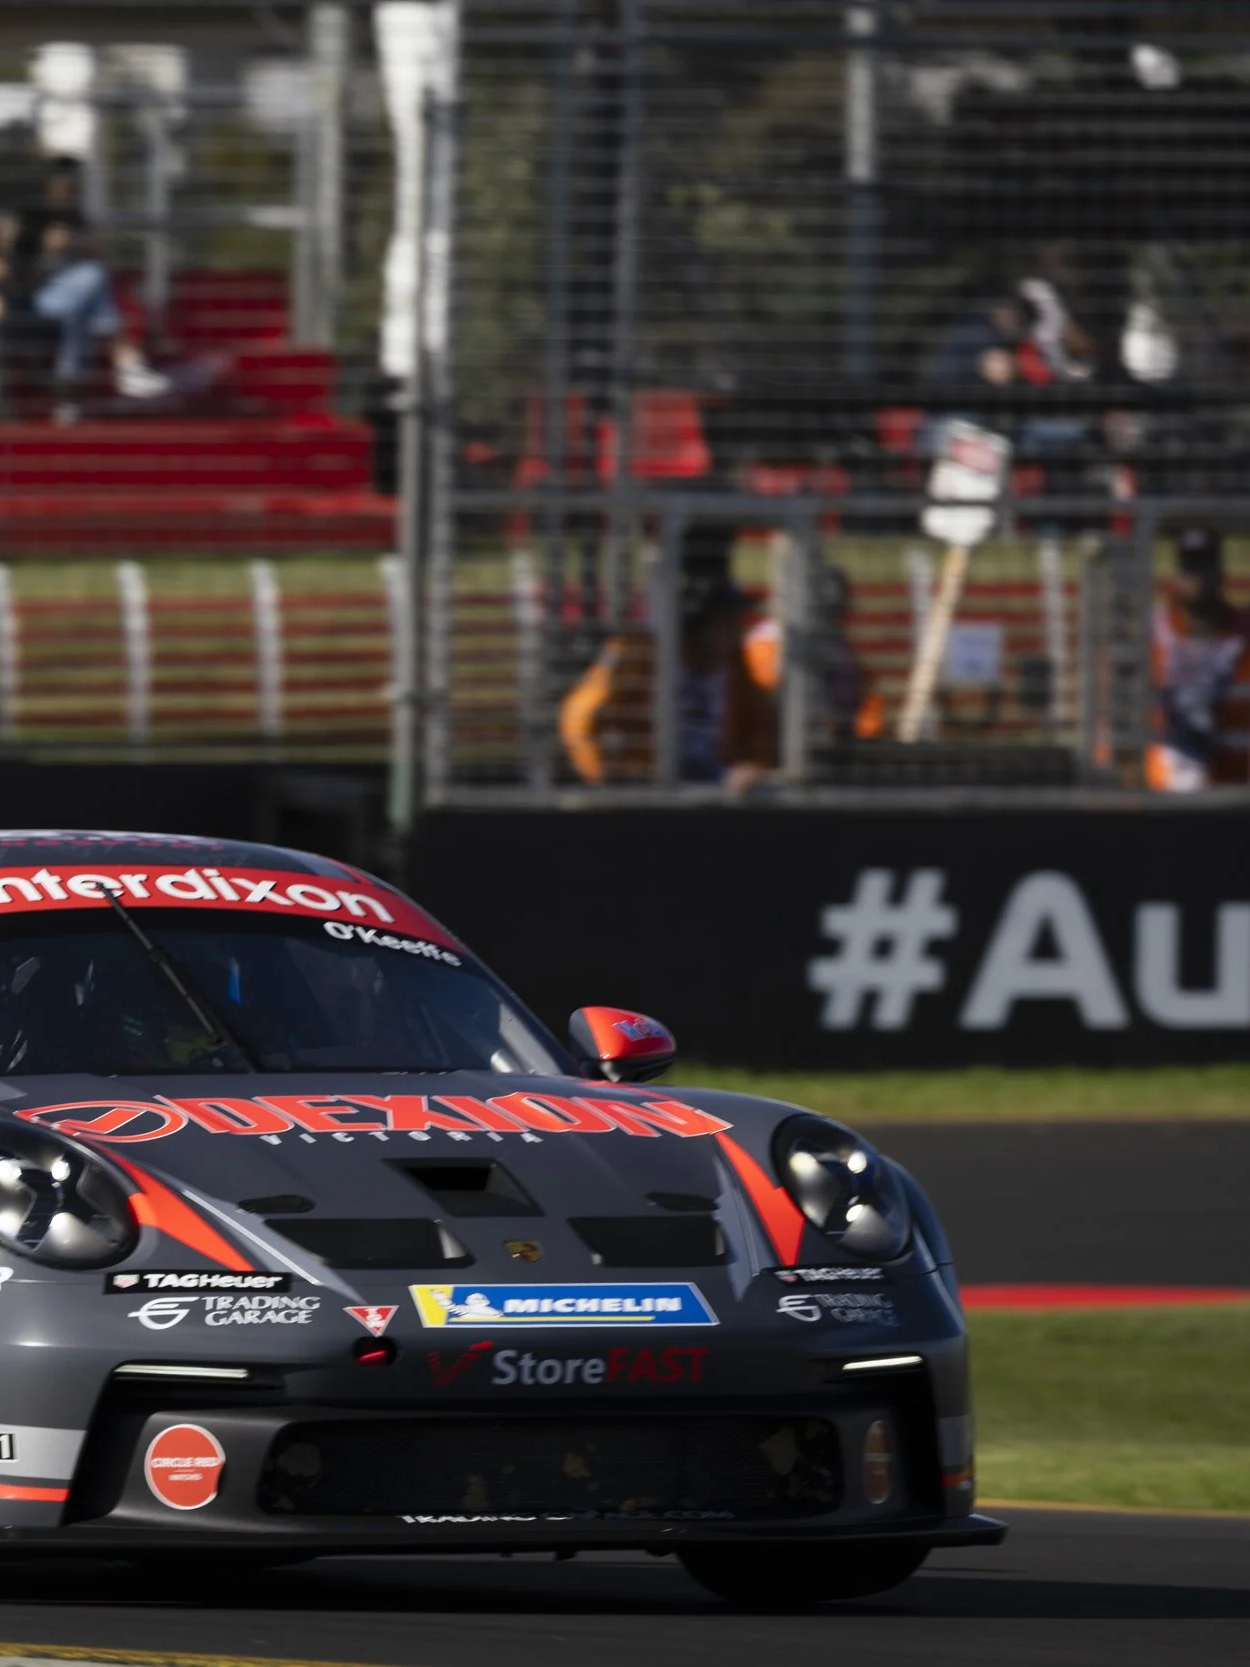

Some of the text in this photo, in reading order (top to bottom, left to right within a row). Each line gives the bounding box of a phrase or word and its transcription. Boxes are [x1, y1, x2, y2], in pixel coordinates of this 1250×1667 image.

[152, 1090, 735, 1138] DEXION
[200, 1296, 322, 1311] TRADING
[503, 1297, 683, 1314] MICHELIN
[204, 1310, 315, 1327] GARAGE
